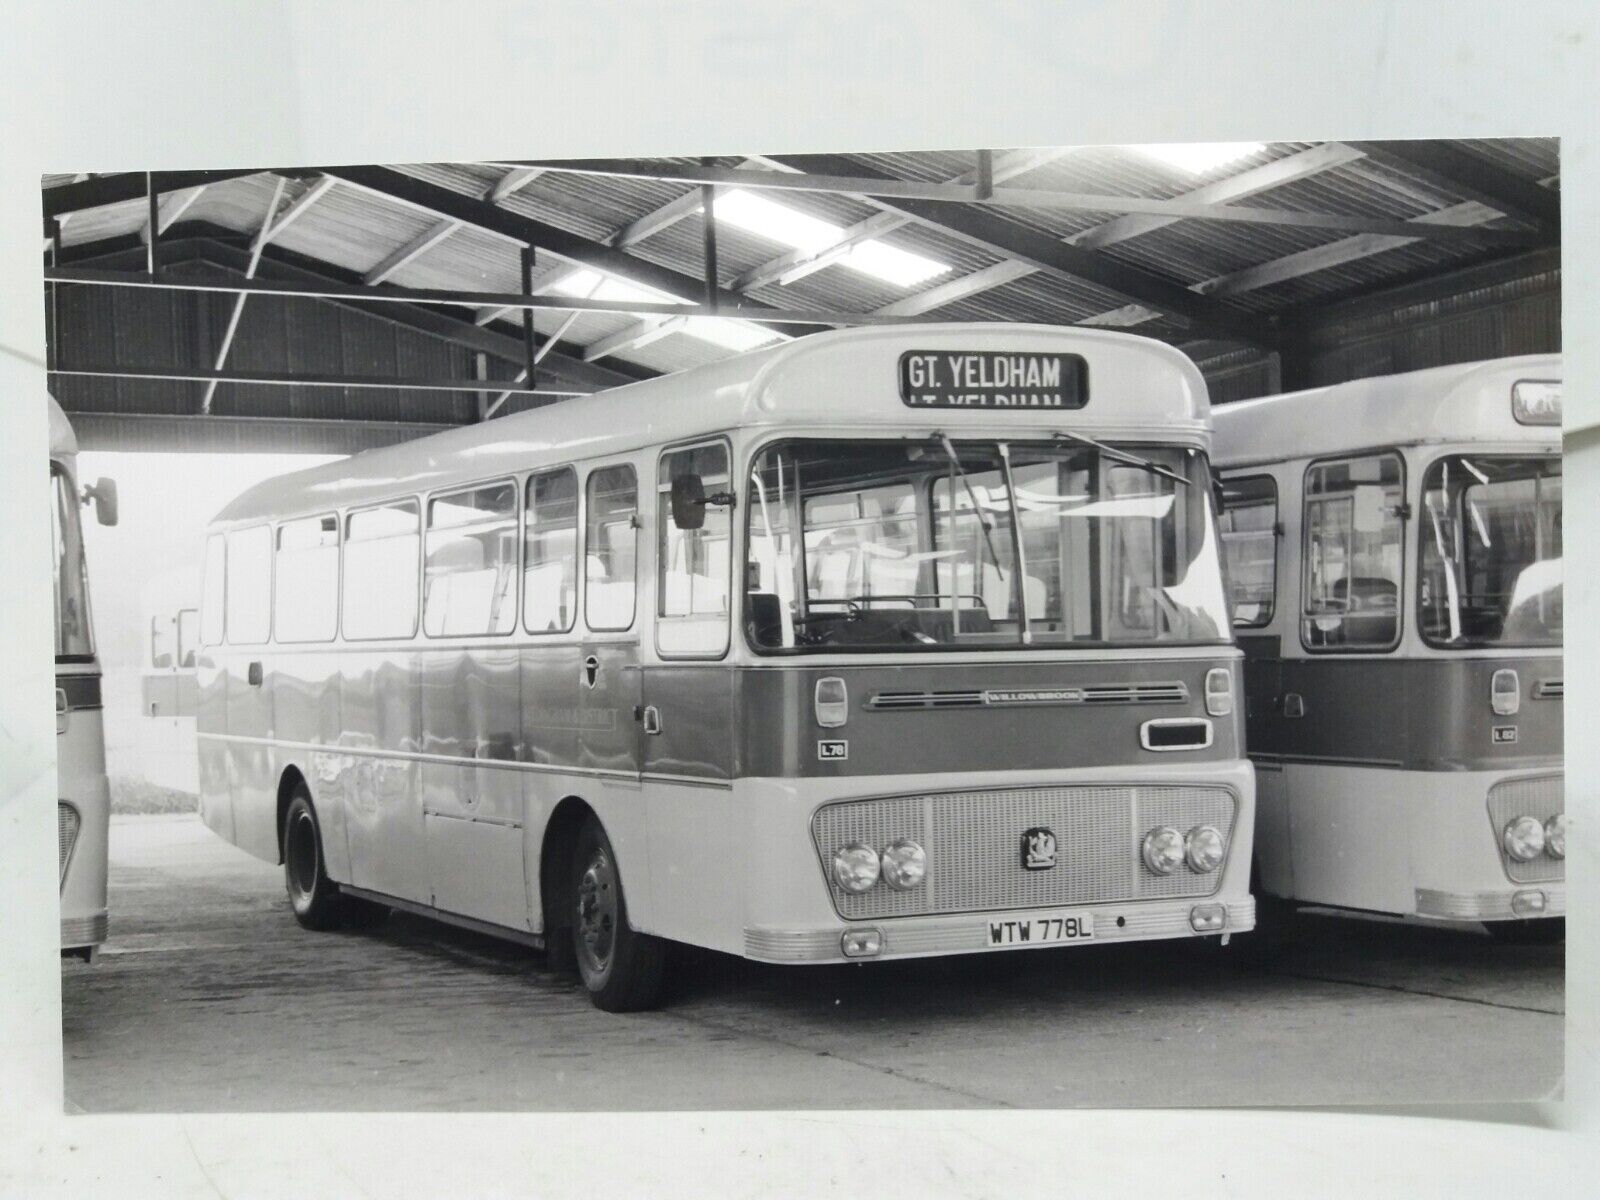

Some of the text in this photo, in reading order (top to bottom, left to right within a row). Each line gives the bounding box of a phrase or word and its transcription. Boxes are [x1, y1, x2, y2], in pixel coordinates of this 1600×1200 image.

[908, 355, 1061, 388] GT. YELDHAM
[988, 692, 1079, 701] WILLOWBROOK
[821, 744, 844, 756] L78
[990, 917, 1091, 944] WTW 778L
